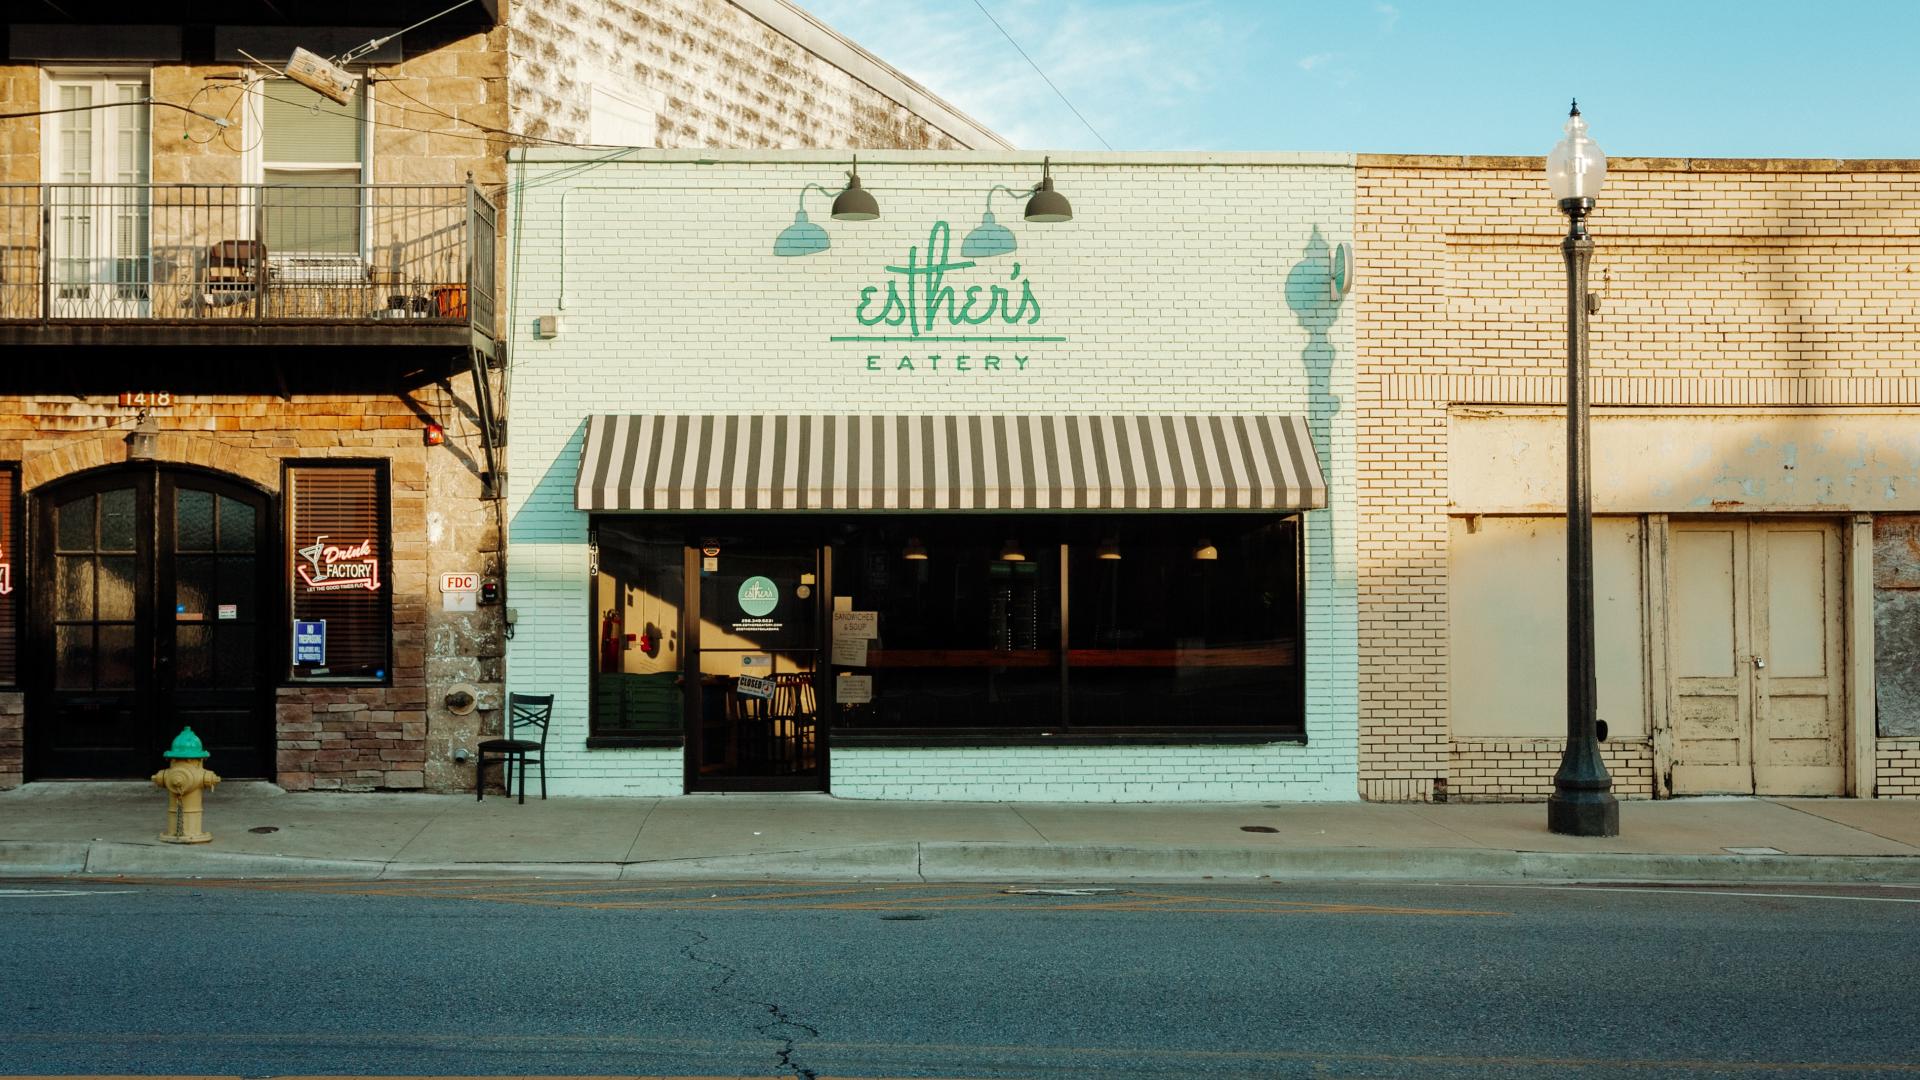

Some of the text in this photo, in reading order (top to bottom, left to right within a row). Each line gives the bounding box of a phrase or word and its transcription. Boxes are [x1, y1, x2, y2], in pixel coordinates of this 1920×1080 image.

[866, 355, 1030, 371] EATERY
[126, 391, 170, 406] 1418
[323, 539, 371, 563] Drink
[327, 564, 372, 578] FACTORY
[447, 577, 472, 588] FDC
[834, 612, 874, 621] SANDWICHES
[740, 676, 763, 689] CLOSED
